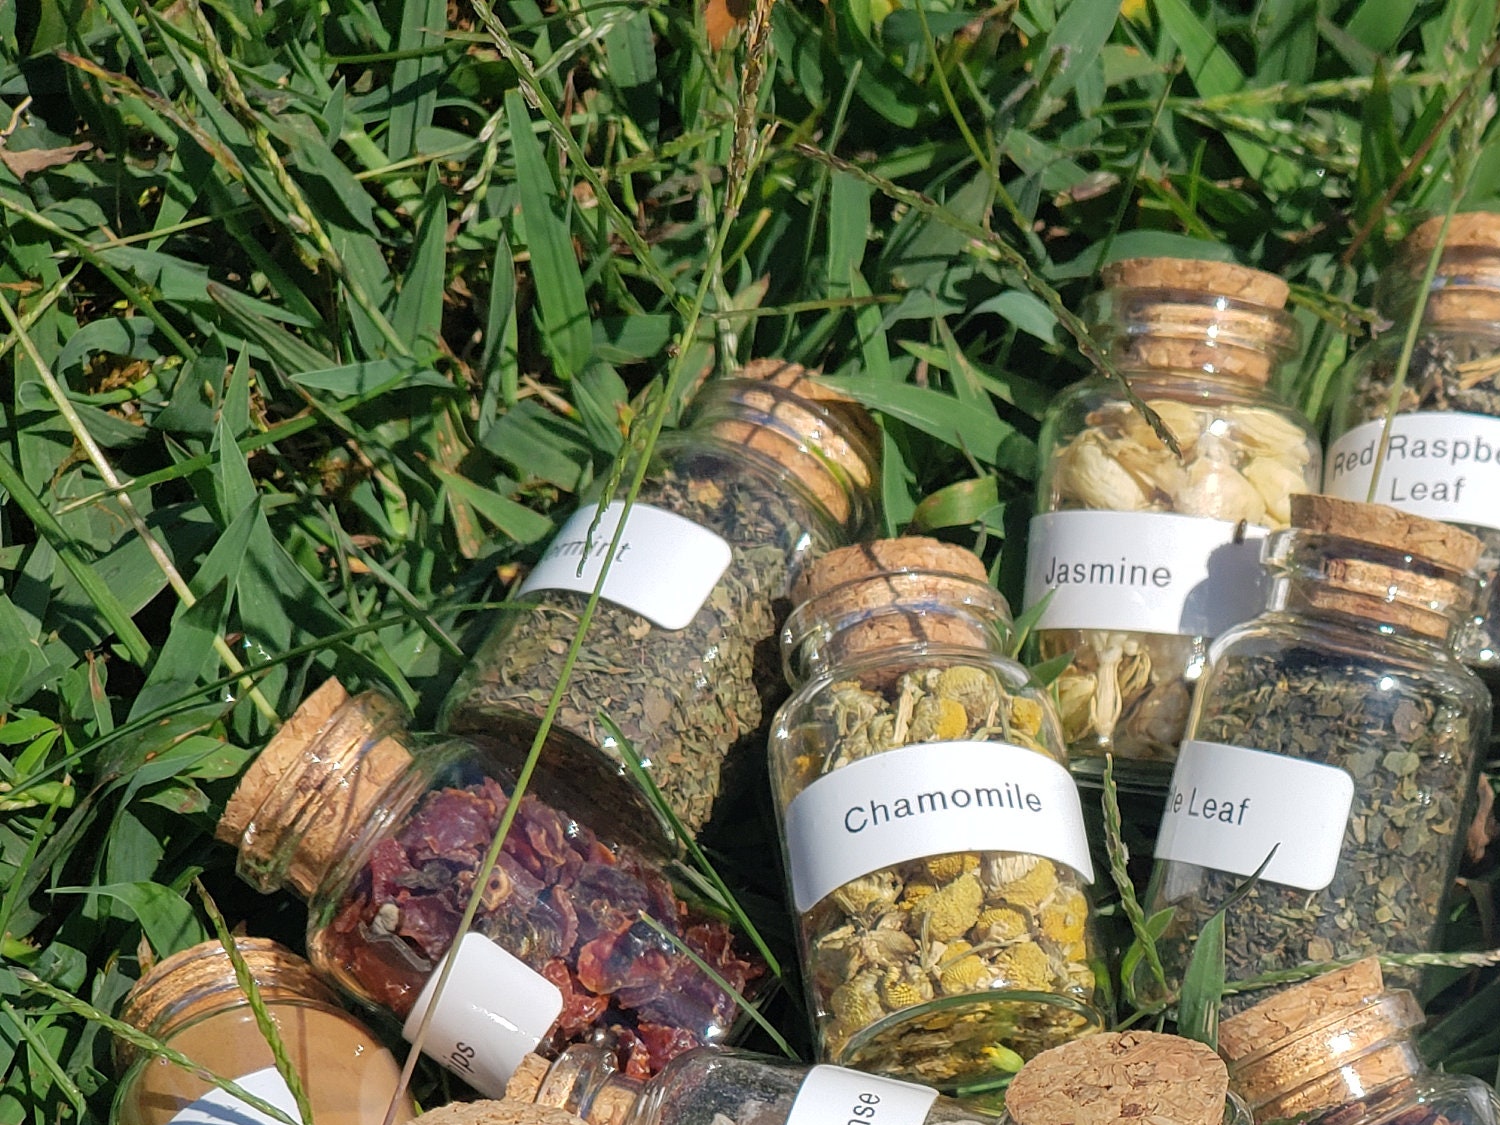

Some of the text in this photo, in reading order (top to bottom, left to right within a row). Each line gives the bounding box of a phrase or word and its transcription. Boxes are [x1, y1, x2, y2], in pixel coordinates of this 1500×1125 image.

[1332, 439, 1376, 481] Red
[1391, 476, 1466, 503] Leaf
[1045, 555, 1172, 588] Jasmine
[844, 782, 1043, 834] Chamomile
[1188, 787, 1251, 826] Leaf
